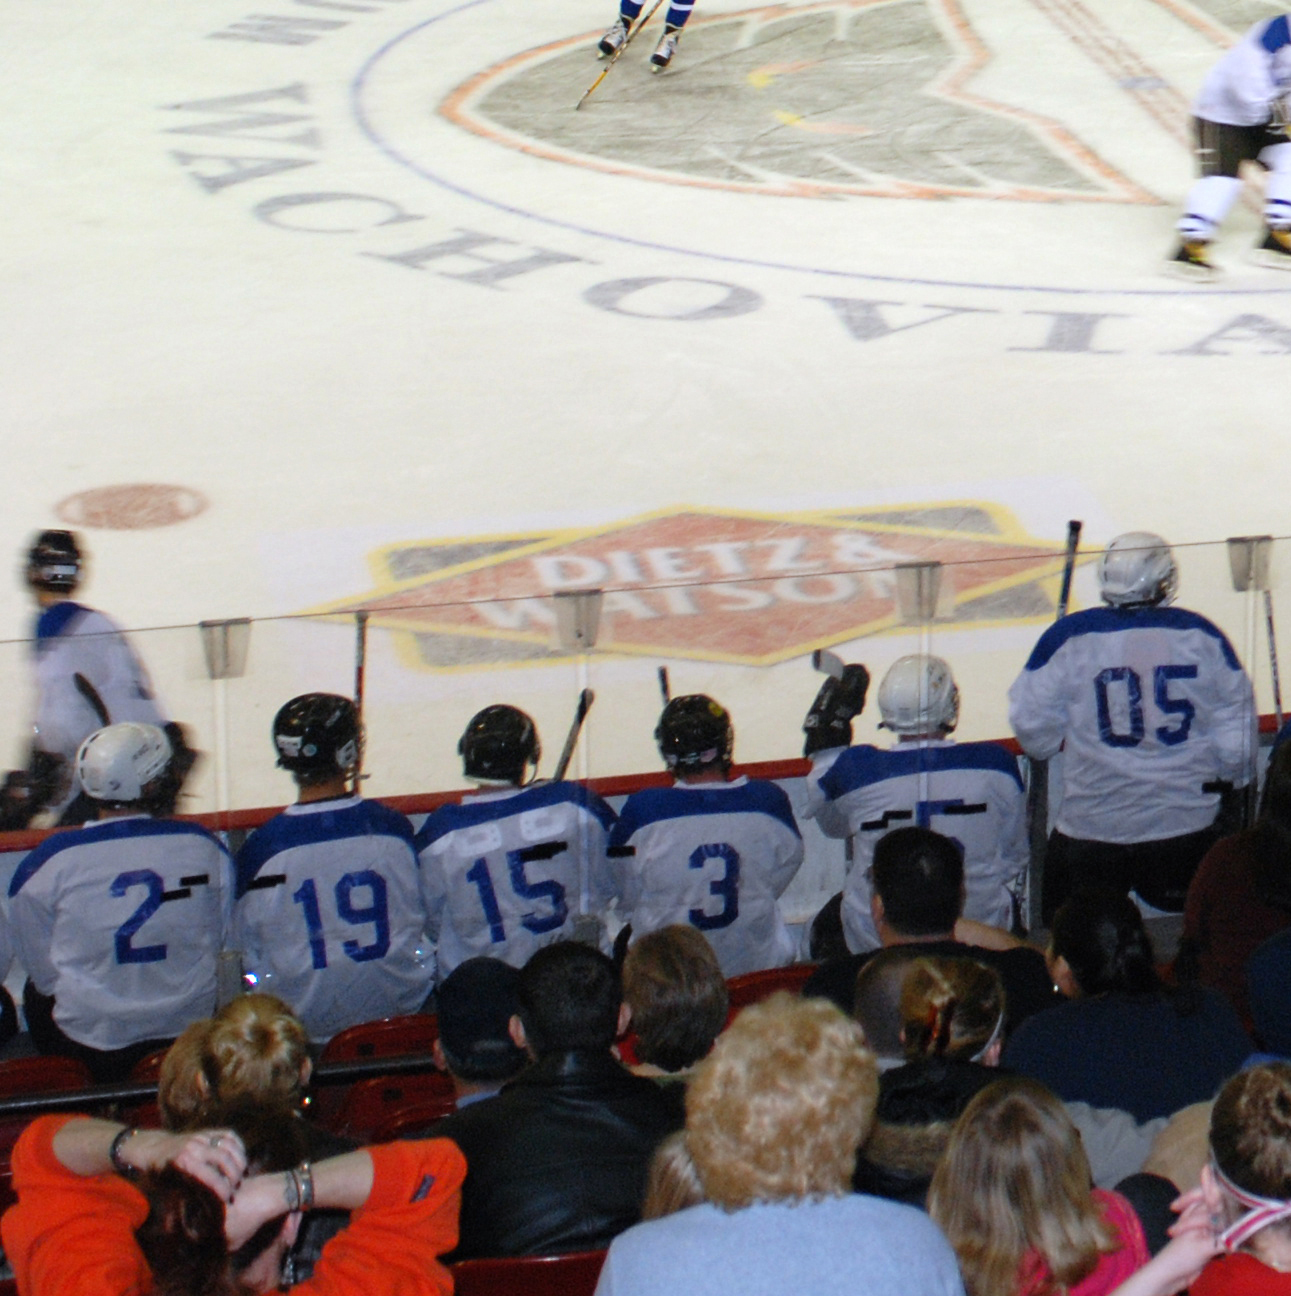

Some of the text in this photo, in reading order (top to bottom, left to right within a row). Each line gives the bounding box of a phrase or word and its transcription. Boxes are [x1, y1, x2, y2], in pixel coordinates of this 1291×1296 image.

[531, 532, 920, 588] DIETZ &
[1094, 665, 1199, 748] 05
[109, 867, 168, 965] 2
[293, 868, 391, 970] 19
[465, 846, 569, 944] 15
[687, 841, 740, 931] 3
